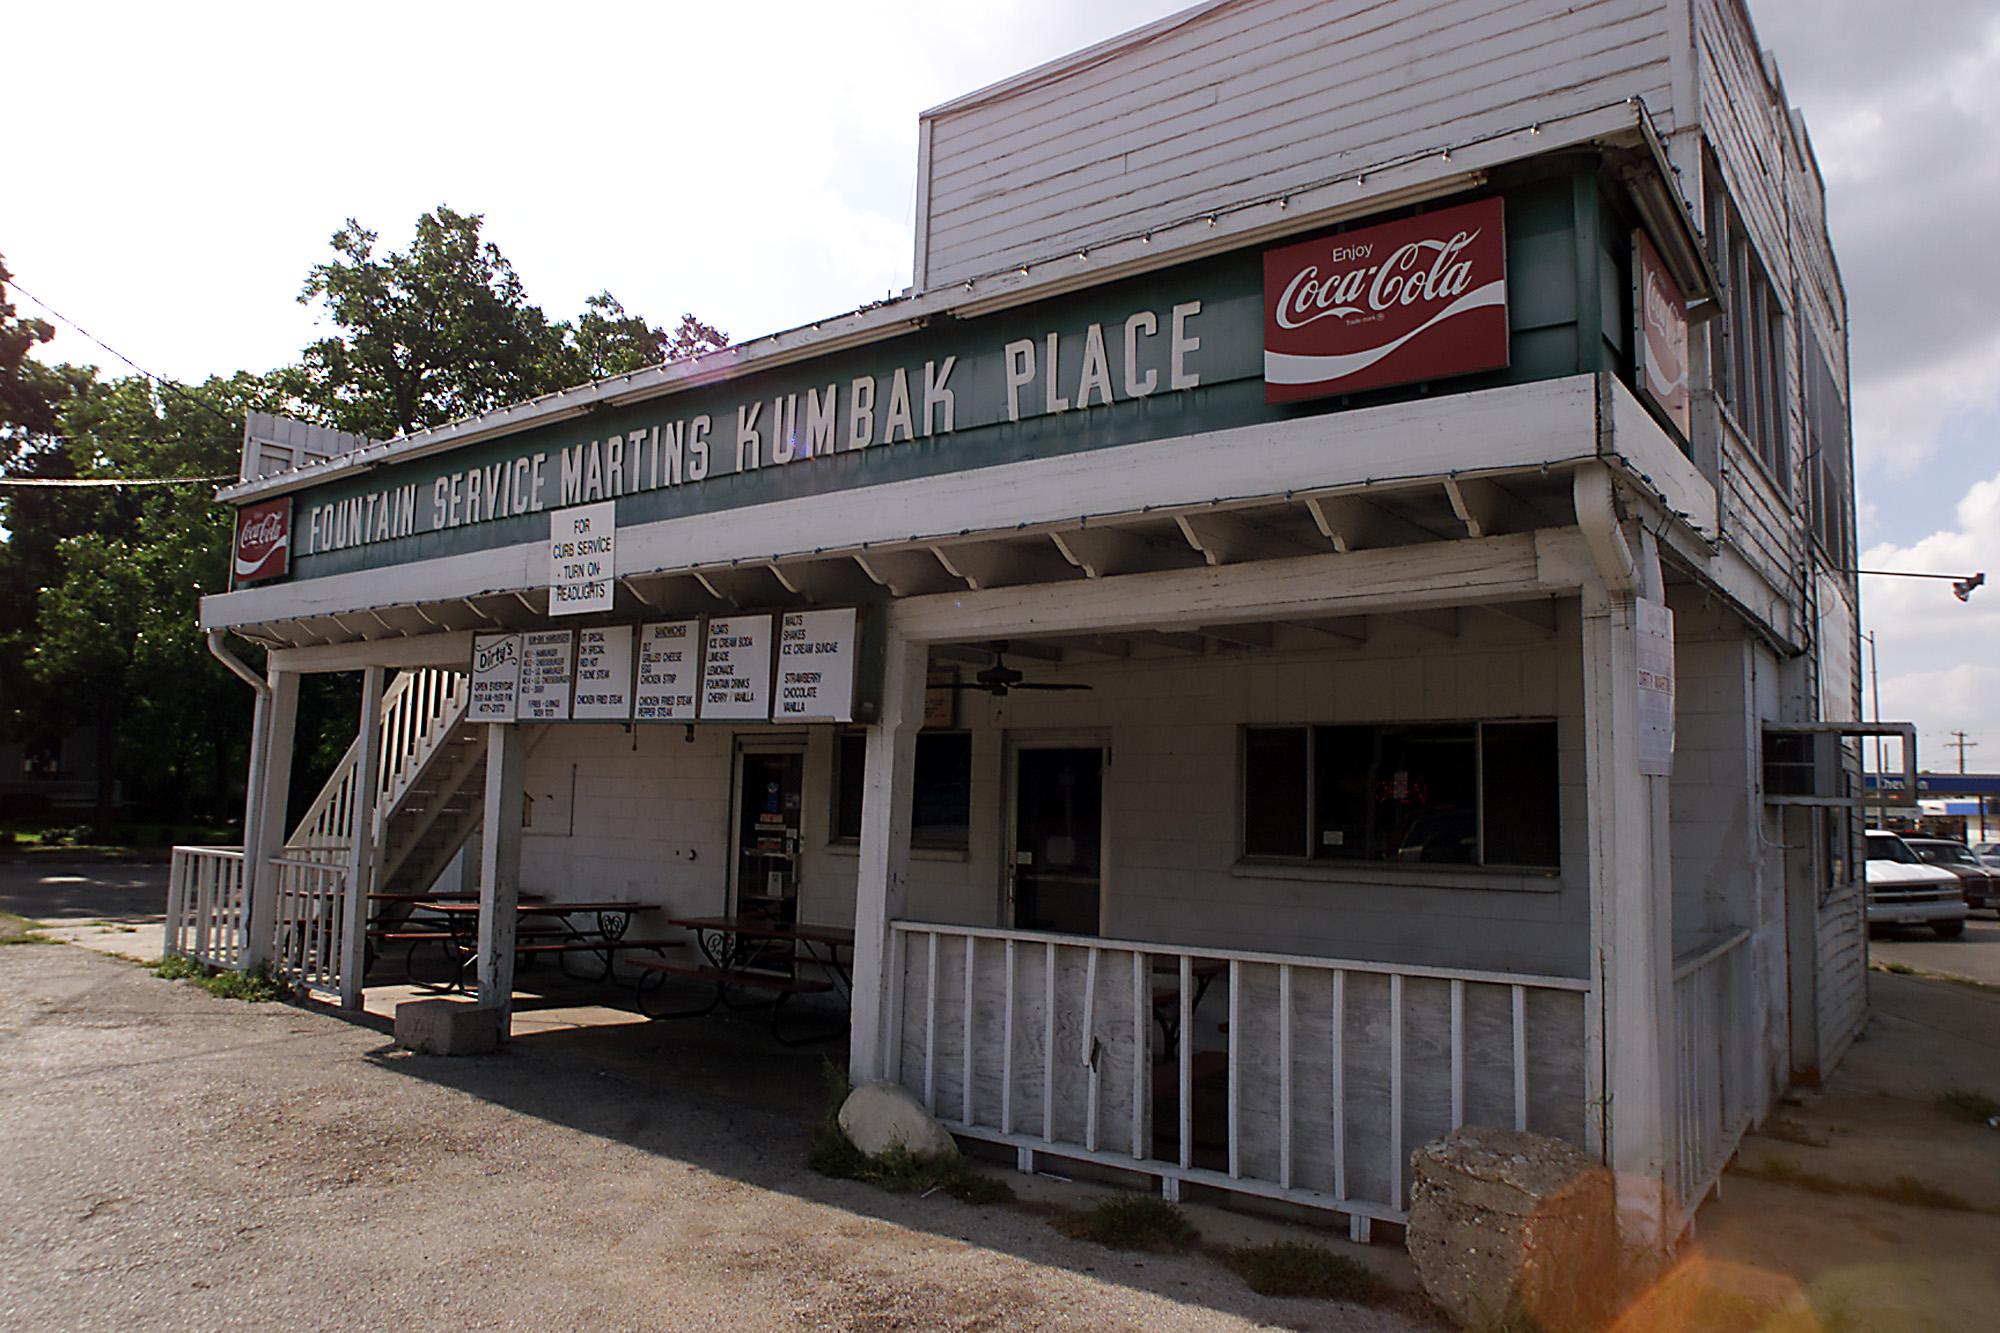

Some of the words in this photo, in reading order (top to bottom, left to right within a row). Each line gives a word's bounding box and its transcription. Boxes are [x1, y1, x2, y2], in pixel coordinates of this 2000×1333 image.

[1332, 243, 1373, 262] Enjoy
[1276, 227, 1481, 329] Coca-Cola
[310, 484, 416, 554] FOUNTAIN
[433, 452, 547, 529] SERVICE
[560, 414, 711, 507] MARTINS
[735, 355, 957, 473] KUMBAK
[1004, 300, 1201, 422] PLACE
[241, 512, 284, 549] Coca-Cola
[574, 518, 590, 534] FOR
[553, 543, 574, 559] CURB
[577, 537, 611, 556] SERVICE
[564, 564, 585, 579] TURN
[587, 562, 600, 577] ON
[557, 583, 605, 601] HEADLIGHTS
[785, 615, 803, 626] MALTS
[655, 625, 687, 638] SANDWICHES
[710, 624, 729, 635] FLOATS
[783, 629, 806, 640] SHAKES
[642, 643, 652, 652] BLT
[709, 639, 717, 649] ICE
[719, 637, 737, 648] CREAM
[738, 637, 752, 647] SODA
[783, 644, 792, 655] ICE
[794, 643, 813, 654] CREAM
[815, 642, 839, 654] SUNDAE
[480, 641, 513, 668] Dirty's
[642, 653, 661, 663] GRILLED
[663, 652, 682, 662] CHEESE
[708, 652, 729, 662] LIMEADE
[579, 670, 595, 679] T-BONE
[596, 669, 610, 679] STEAK
[641, 664, 651, 674] EGG
[707, 664, 734, 676] LEMONADE
[640, 674, 661, 684] CHICKEN
[663, 674, 677, 684] STRIP
[785, 672, 823, 683] STRAWBERRY
[474, 682, 488, 691] OPEN
[706, 678, 730, 689] FOUNTAIN
[731, 678, 750, 689] DRINKS
[708, 692, 727, 703] CHERRY
[734, 692, 754, 702] VANILLA
[784, 687, 817, 698] CHOCOLATE
[577, 695, 595, 704] CHICKEN
[596, 695, 608, 704] FRIED
[609, 695, 623, 704] STEAK
[639, 696, 659, 706] CHICKEN
[661, 696, 675, 706] FRIED
[676, 695, 692, 706] STEAK
[638, 707, 656, 717] PEPPER
[657, 707, 672, 717] STEAK
[783, 702, 805, 712] VANILLA
